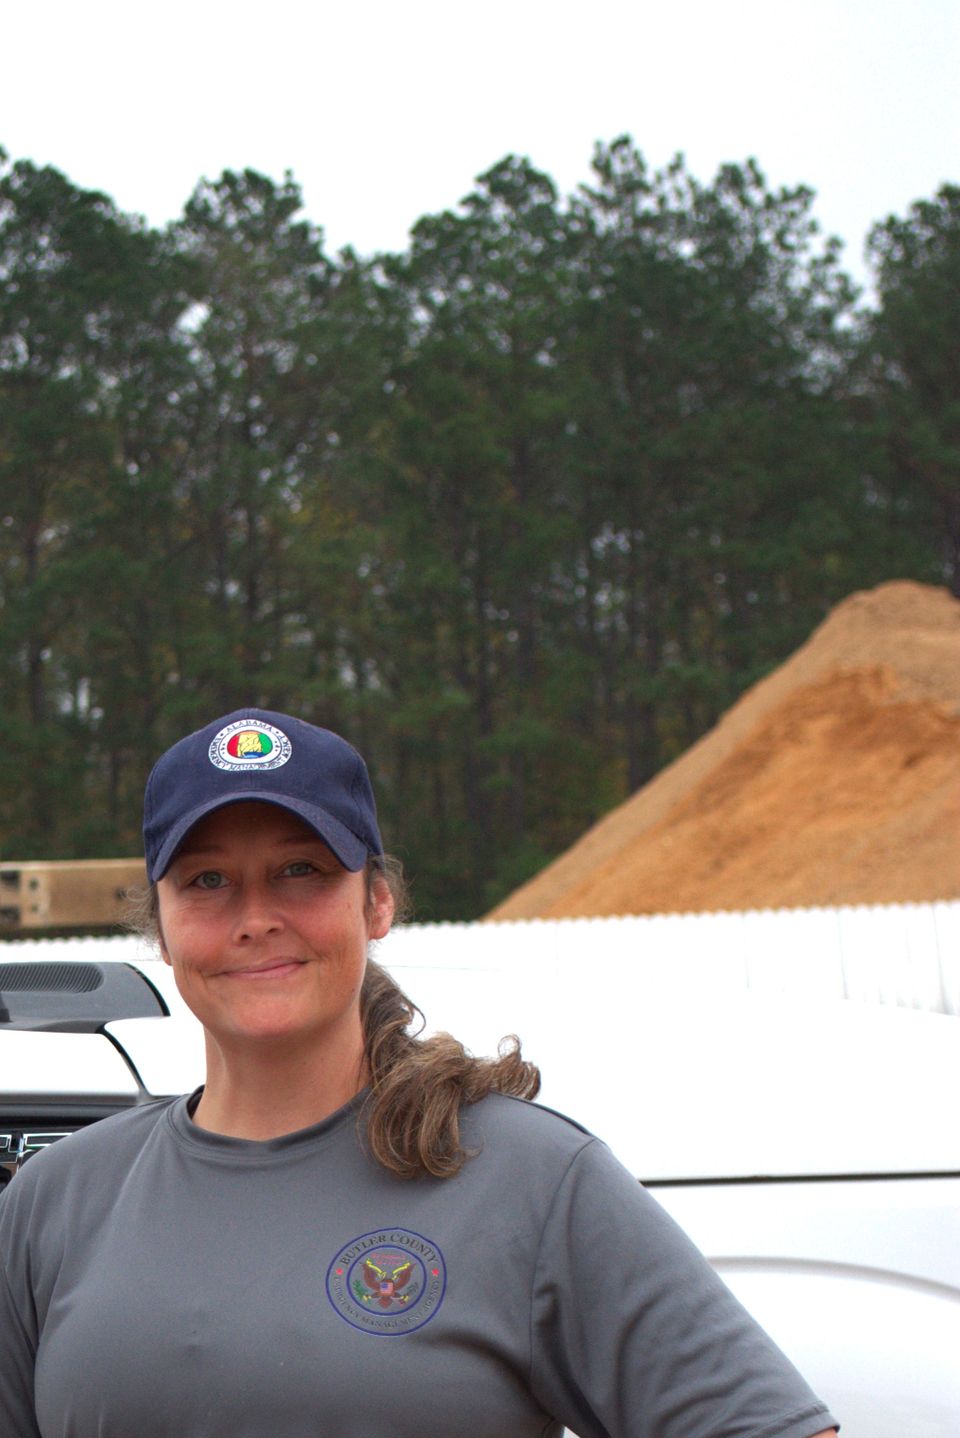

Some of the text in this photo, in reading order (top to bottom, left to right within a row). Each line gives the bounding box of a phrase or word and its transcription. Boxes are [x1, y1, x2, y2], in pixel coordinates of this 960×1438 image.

[226, 720, 273, 732] ALABAMA
[340, 1235, 386, 1265] BUTLER
[391, 1234, 439, 1264] COUNTY
